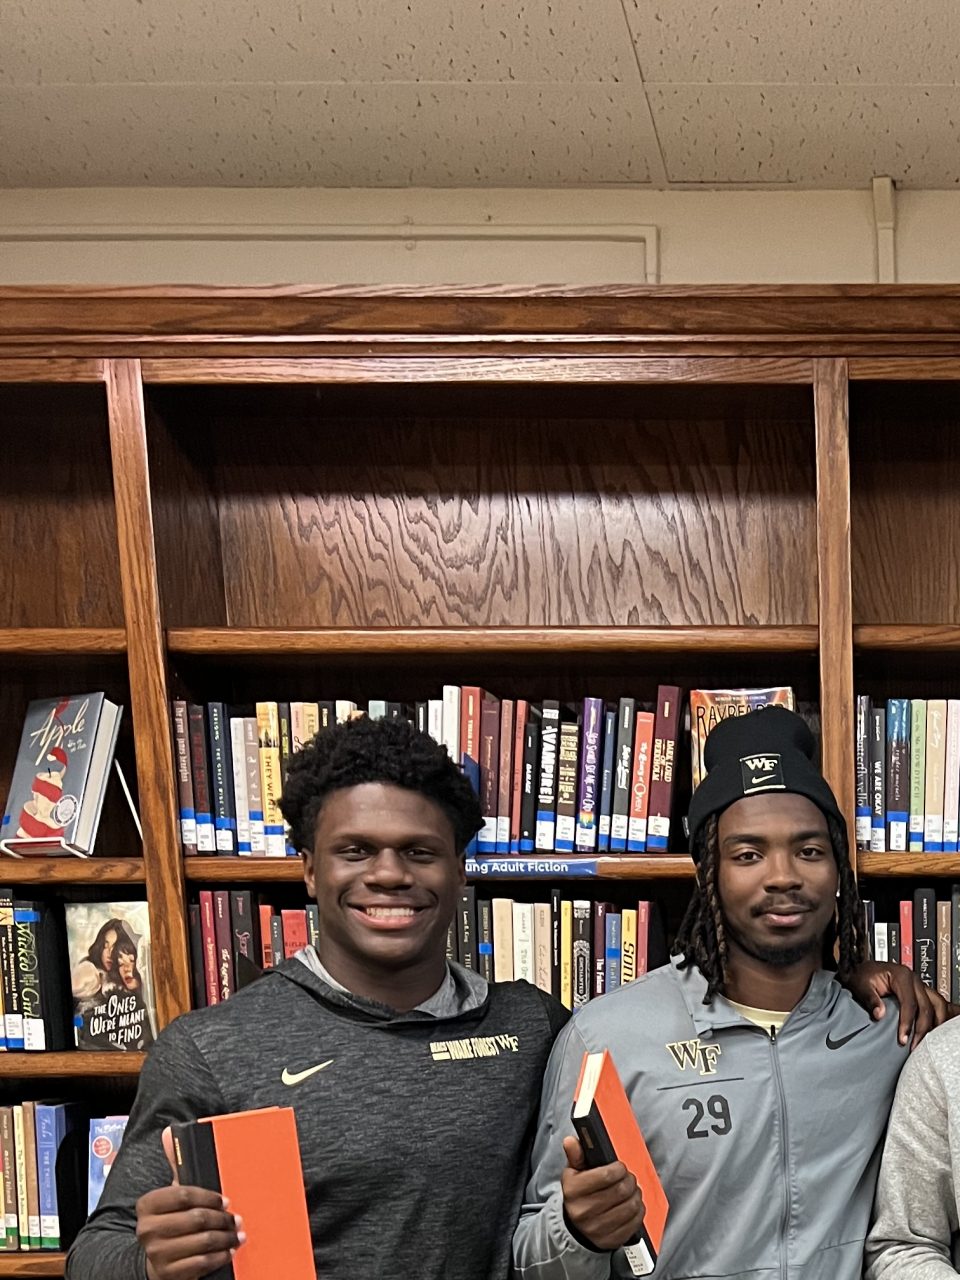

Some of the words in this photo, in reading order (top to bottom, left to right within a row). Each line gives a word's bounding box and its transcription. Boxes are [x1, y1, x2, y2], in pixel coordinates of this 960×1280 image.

[30, 697, 87, 766] Apple
[652, 738, 662, 781] DERKHOLM
[665, 740, 675, 760] DARK
[264, 755, 273, 779] THEY
[663, 761, 673, 783] LORD
[745, 757, 777, 771] WF
[874, 761, 882, 773] WE
[856, 782, 867, 807] yello
[874, 776, 882, 791] ARE
[874, 793, 882, 816] OKAY
[465, 863, 489, 875] ung
[492, 861, 524, 872] Adult
[528, 859, 570, 872] Fiction
[15, 921, 38, 972] Wicked
[595, 958, 605, 970] The
[94, 1004, 107, 1016] THE
[108, 995, 137, 1018] ONES
[118, 1009, 145, 1027] MEANT
[108, 1032, 117, 1042] TO
[118, 1024, 142, 1045] FIND
[666, 1039, 722, 1076] WF
[682, 1094, 733, 1139] 29
